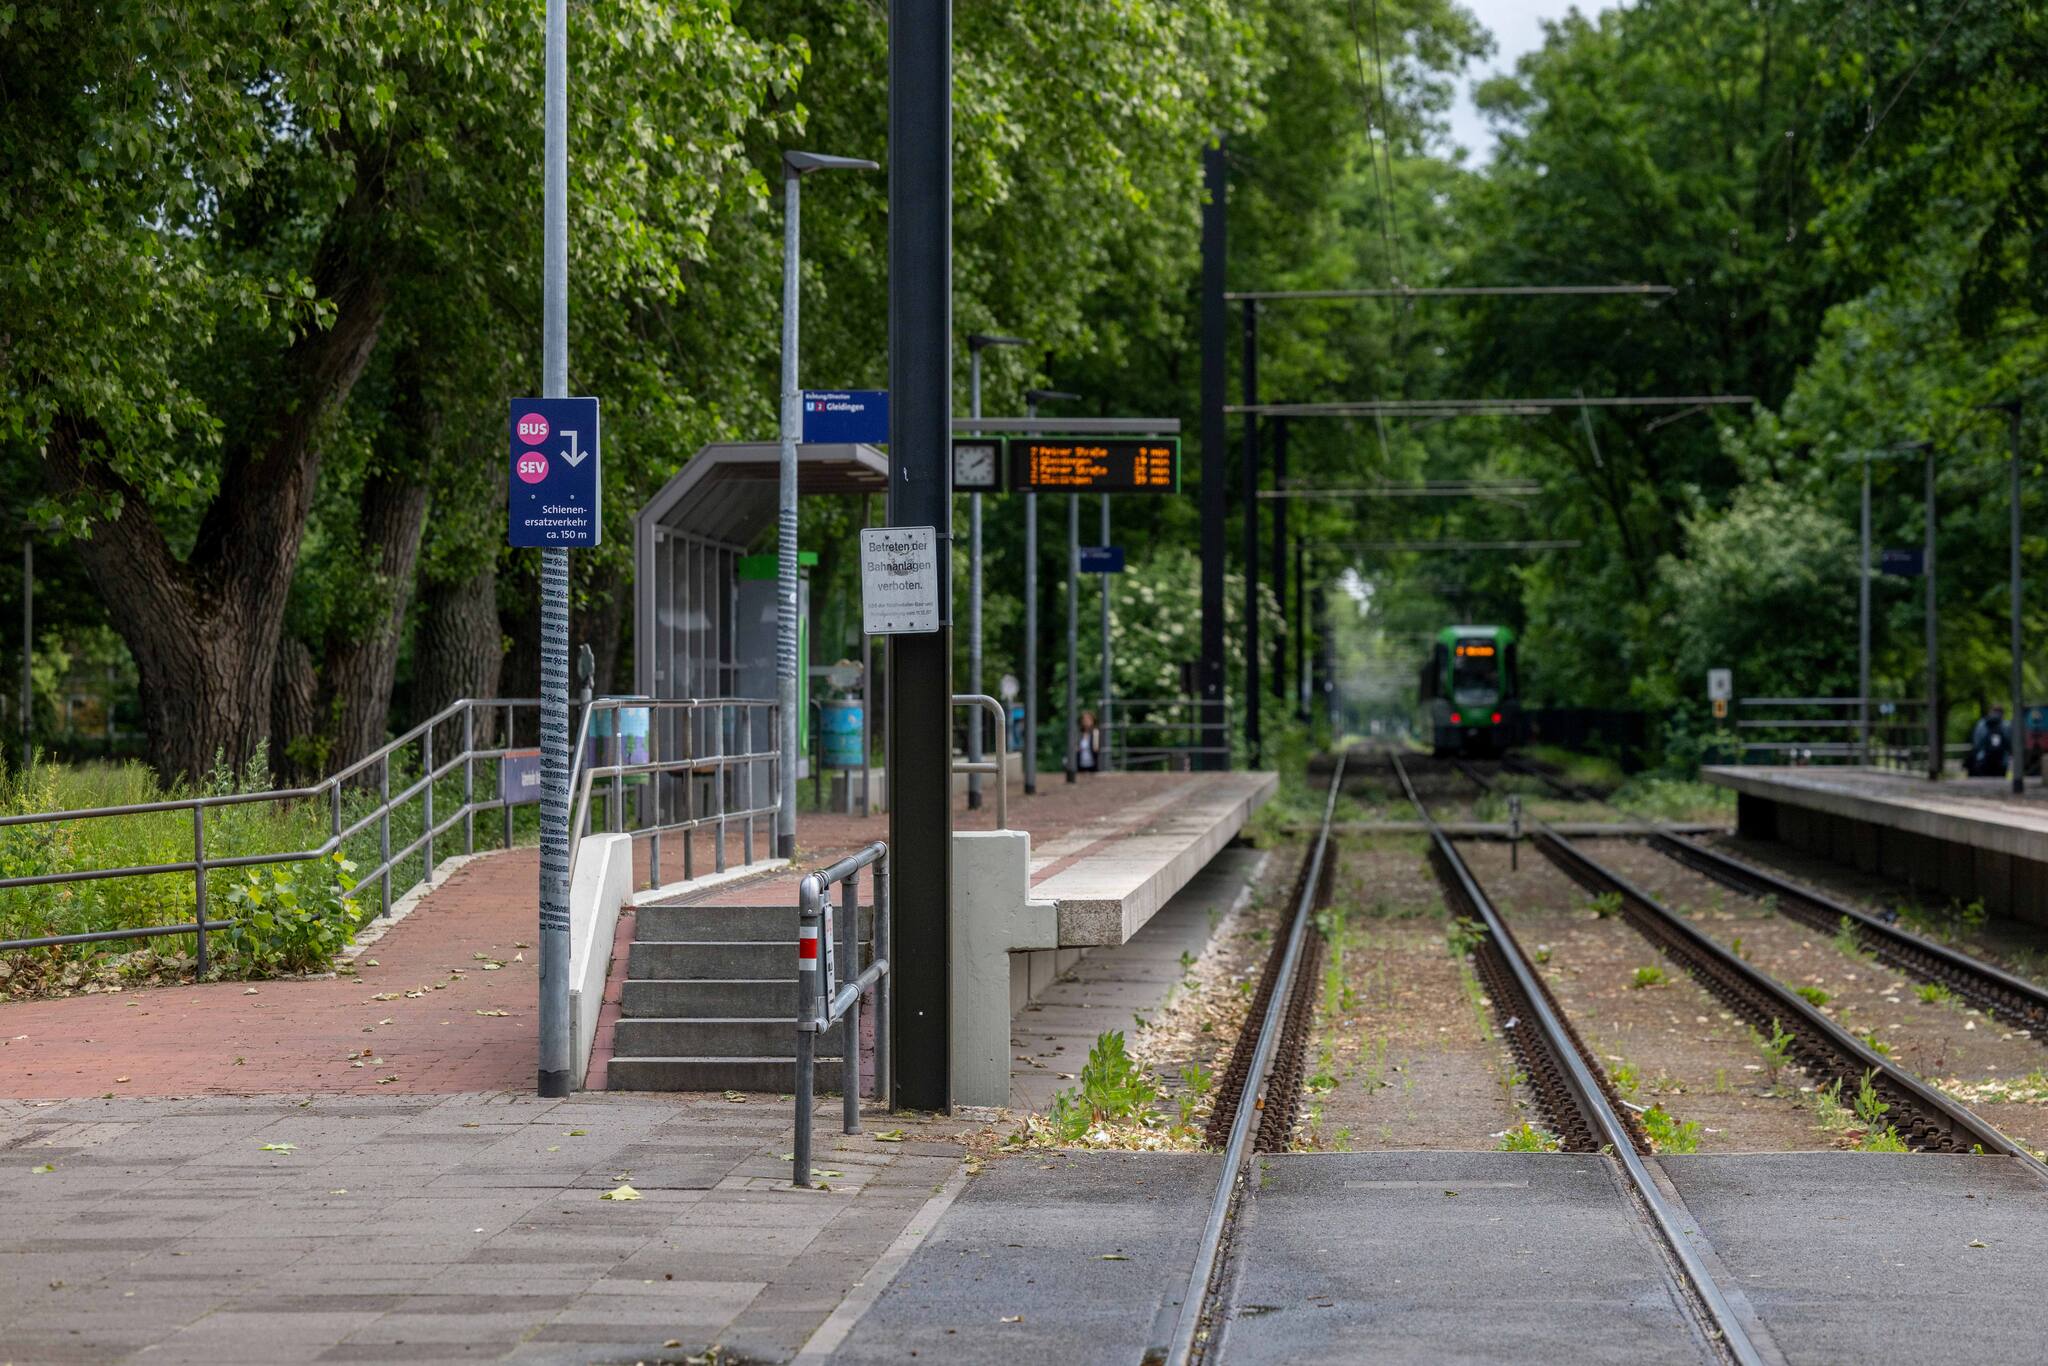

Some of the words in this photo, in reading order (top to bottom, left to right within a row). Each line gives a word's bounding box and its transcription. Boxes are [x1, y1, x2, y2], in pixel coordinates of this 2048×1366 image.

[826, 402, 865, 413] Gleidingen
[519, 423, 547, 435] BUS
[519, 461, 546, 473] SEV
[542, 505, 587, 514] Schienen-
[524, 516, 587, 527] ersatzverkehr
[546, 531, 559, 539] ca.
[561, 530, 576, 539] 150
[577, 531, 587, 539] m
[868, 541, 910, 552] Betreten
[911, 541, 928, 551] der
[867, 561, 931, 572] Bahnanlagen
[877, 580, 923, 592] verboten.
